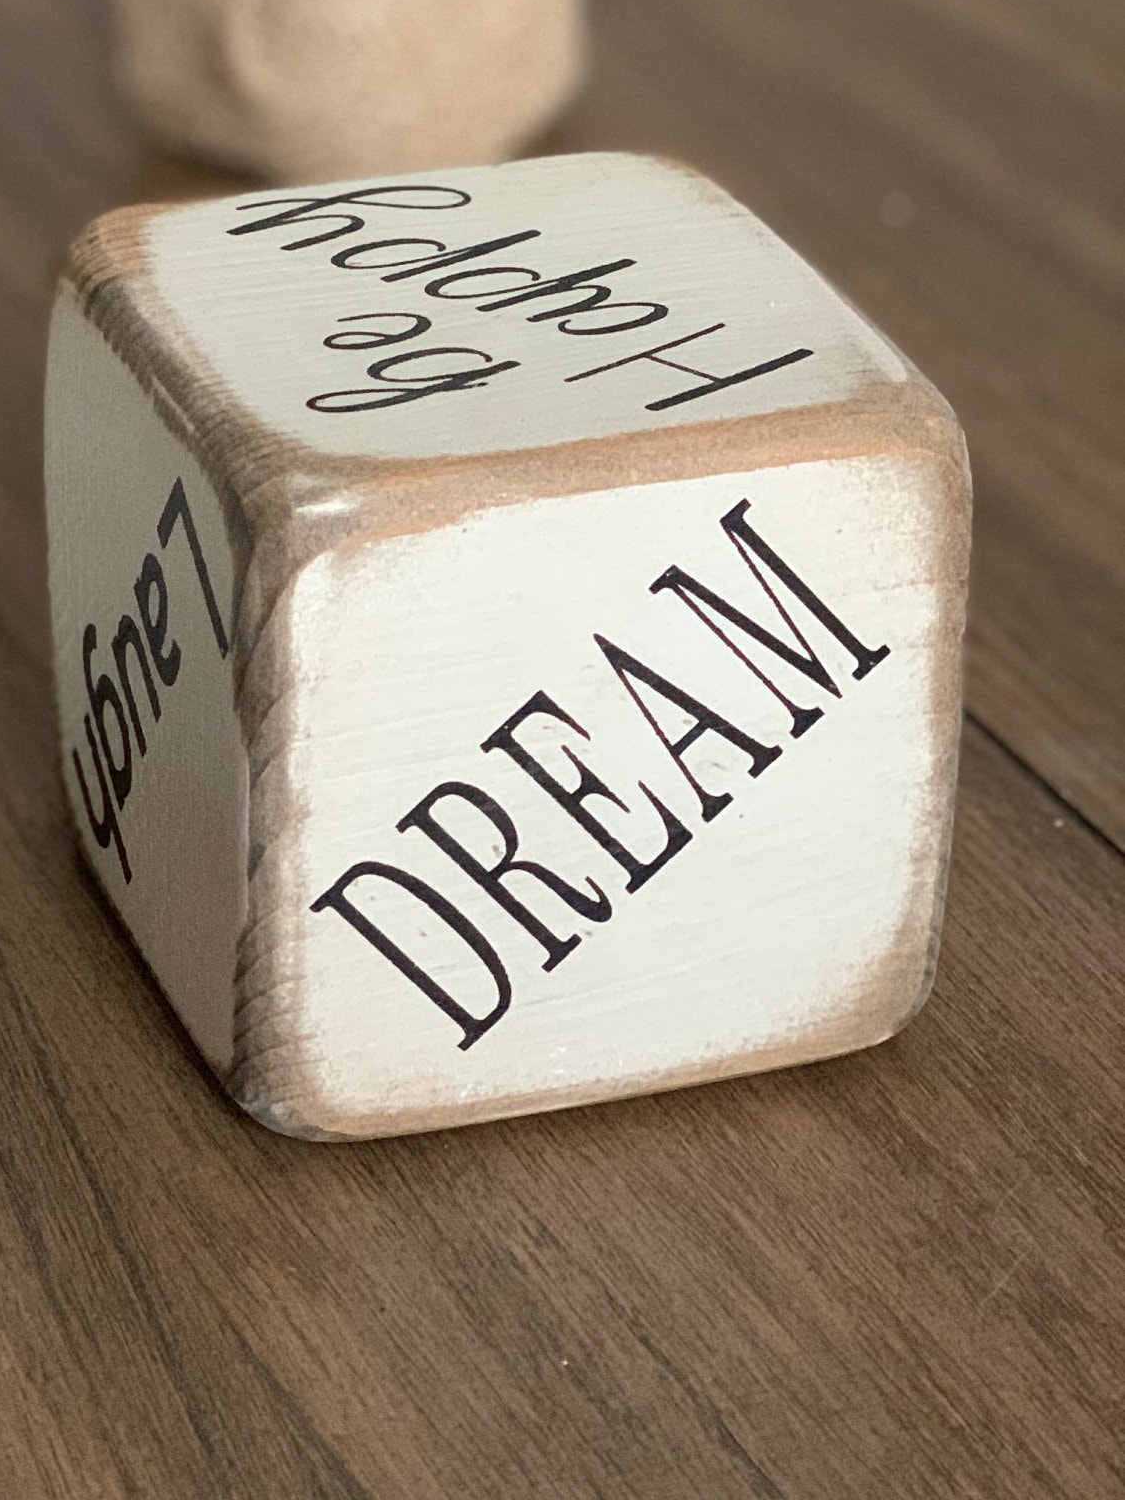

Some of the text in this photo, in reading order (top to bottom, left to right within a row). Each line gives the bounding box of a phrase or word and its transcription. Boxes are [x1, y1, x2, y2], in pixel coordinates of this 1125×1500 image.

[227, 185, 814, 411] Happy
[73, 476, 229, 884] Laugh
[309, 498, 891, 1052] DREAM
